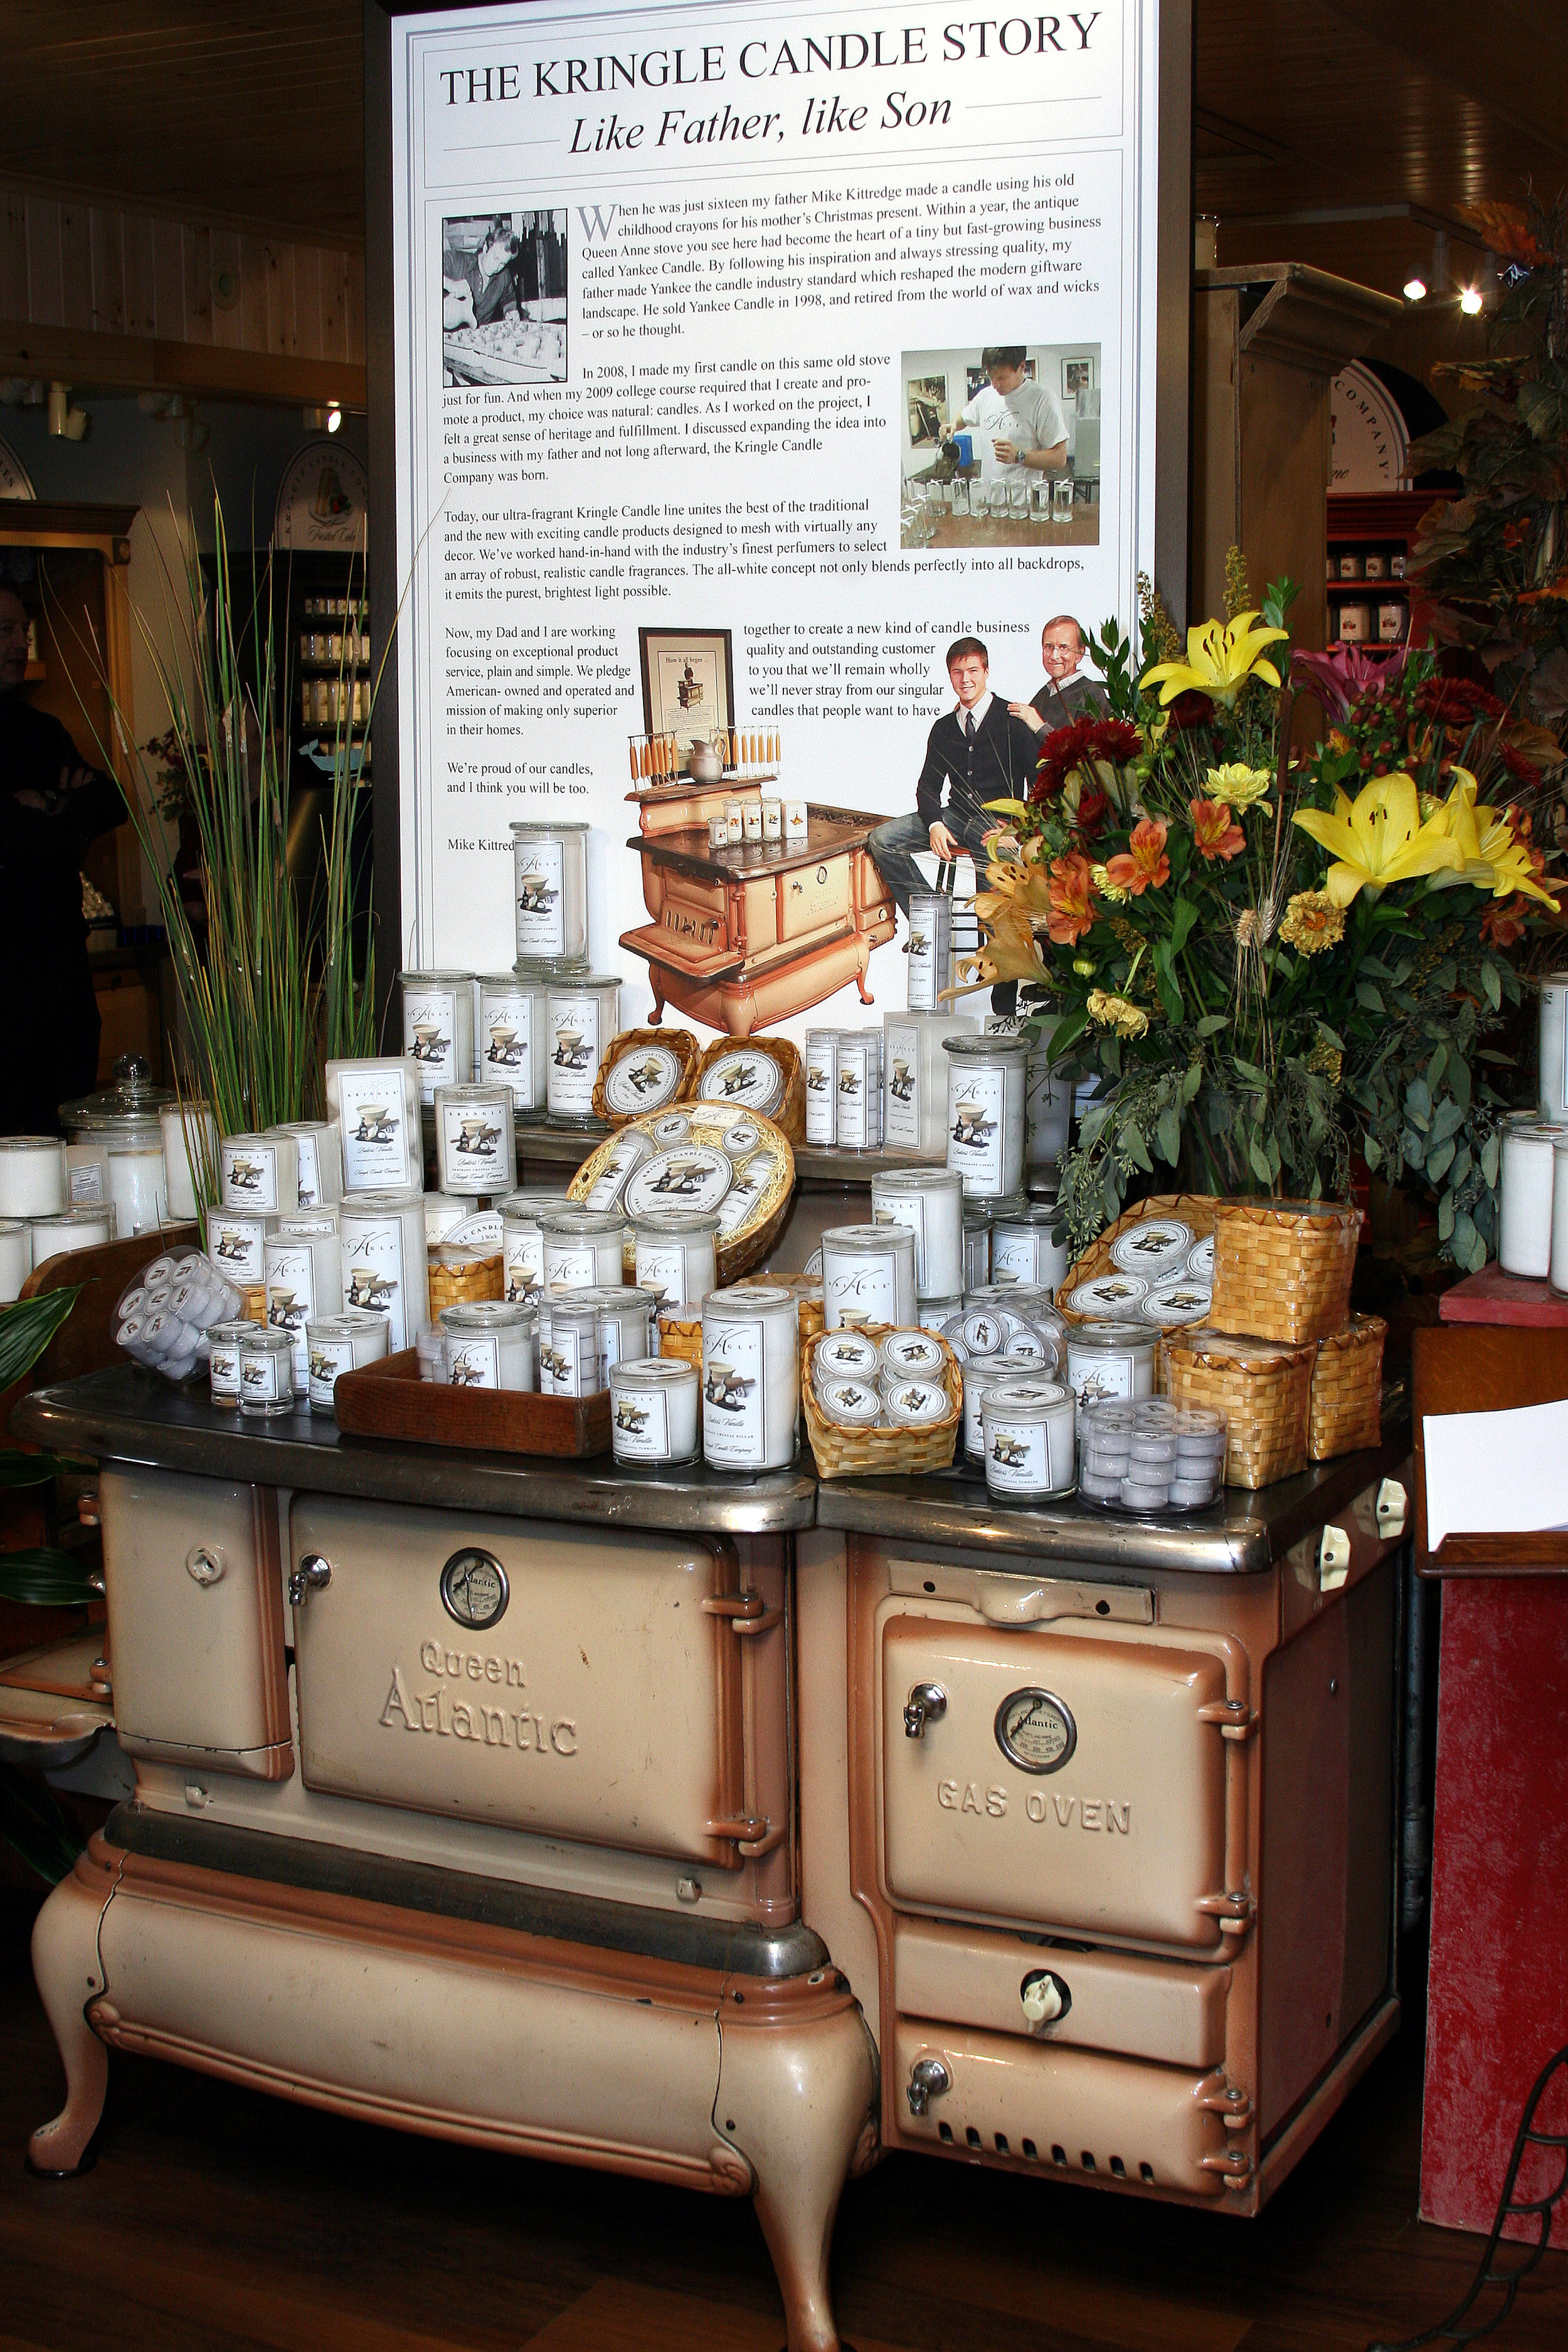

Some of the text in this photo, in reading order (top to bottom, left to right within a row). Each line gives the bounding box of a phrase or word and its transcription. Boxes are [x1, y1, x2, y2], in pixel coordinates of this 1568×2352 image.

[440, 11, 1103, 105] THE KRINGLE CANDLE STORY
[567, 90, 951, 154] Like Father, like Son
[582, 215, 1101, 262] Queen Anne stove you see here had become the heart of a tiny but fast-growing business
[583, 260, 1083, 300] father made Yankee the candle industry standard which reshaped the modern giftware
[582, 354, 891, 379] In 2008, I made my first candle on this same old stove
[443, 415, 886, 447] felt a great sense of heritage and fulfillment. I discussed expanding the idea into
[1334, 380, 1389, 470] COMPANY
[443, 469, 549, 486] Company was born.
[443, 498, 869, 525] Today, our ultra-fragrant Kringle Candle line unites the best of the traditional
[445, 584, 671, 602] it emits the purest, brightest light possible.
[445, 644, 619, 661] focusing on exceptional product
[746, 642, 936, 659] quality and outstanding customer
[446, 684, 635, 699] American- owned and operated and
[751, 703, 941, 719] candles that people want to have
[421, 1638, 526, 1688] Queen
[379, 1666, 578, 1757] Atlantic
[1018, 1716, 1059, 1730] Atlantic
[937, 1780, 1131, 1835] GAS OVEN
